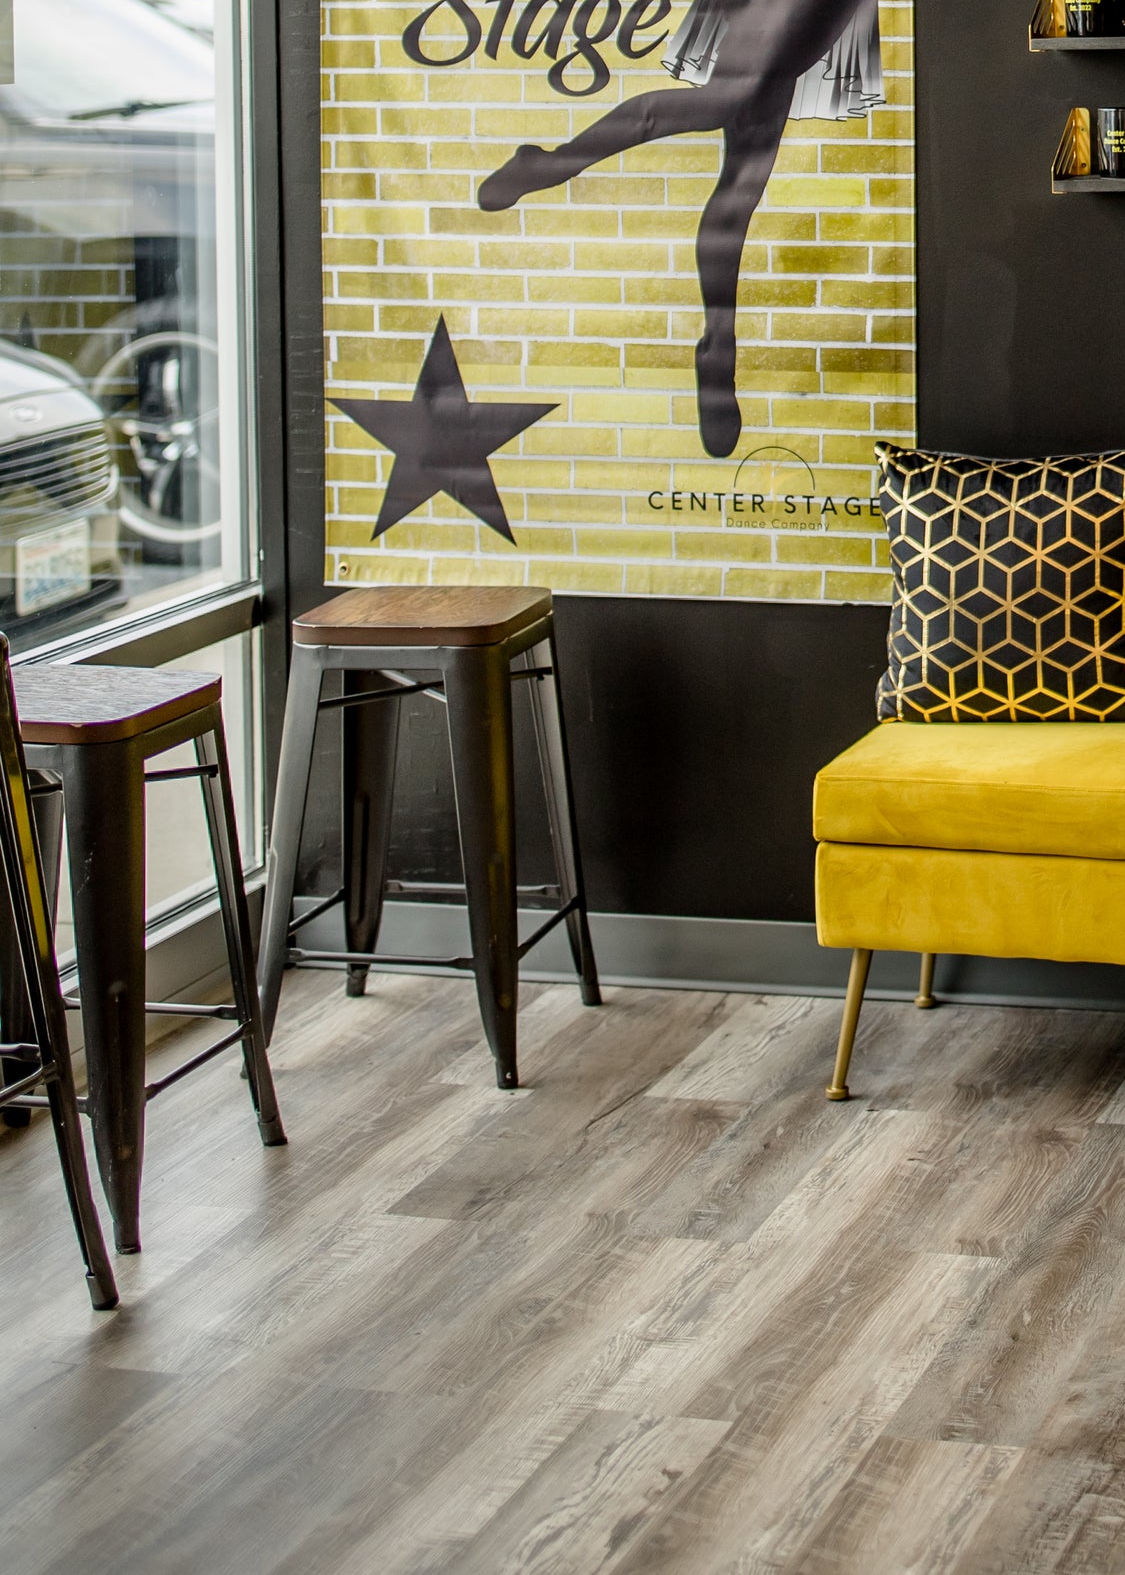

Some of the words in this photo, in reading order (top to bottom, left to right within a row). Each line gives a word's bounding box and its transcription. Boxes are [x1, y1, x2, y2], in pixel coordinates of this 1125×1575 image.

[648, 491, 765, 513] CENTER
[784, 495, 881, 516] STAGE
[726, 518, 766, 529] Dance
[772, 518, 830, 531] Company
